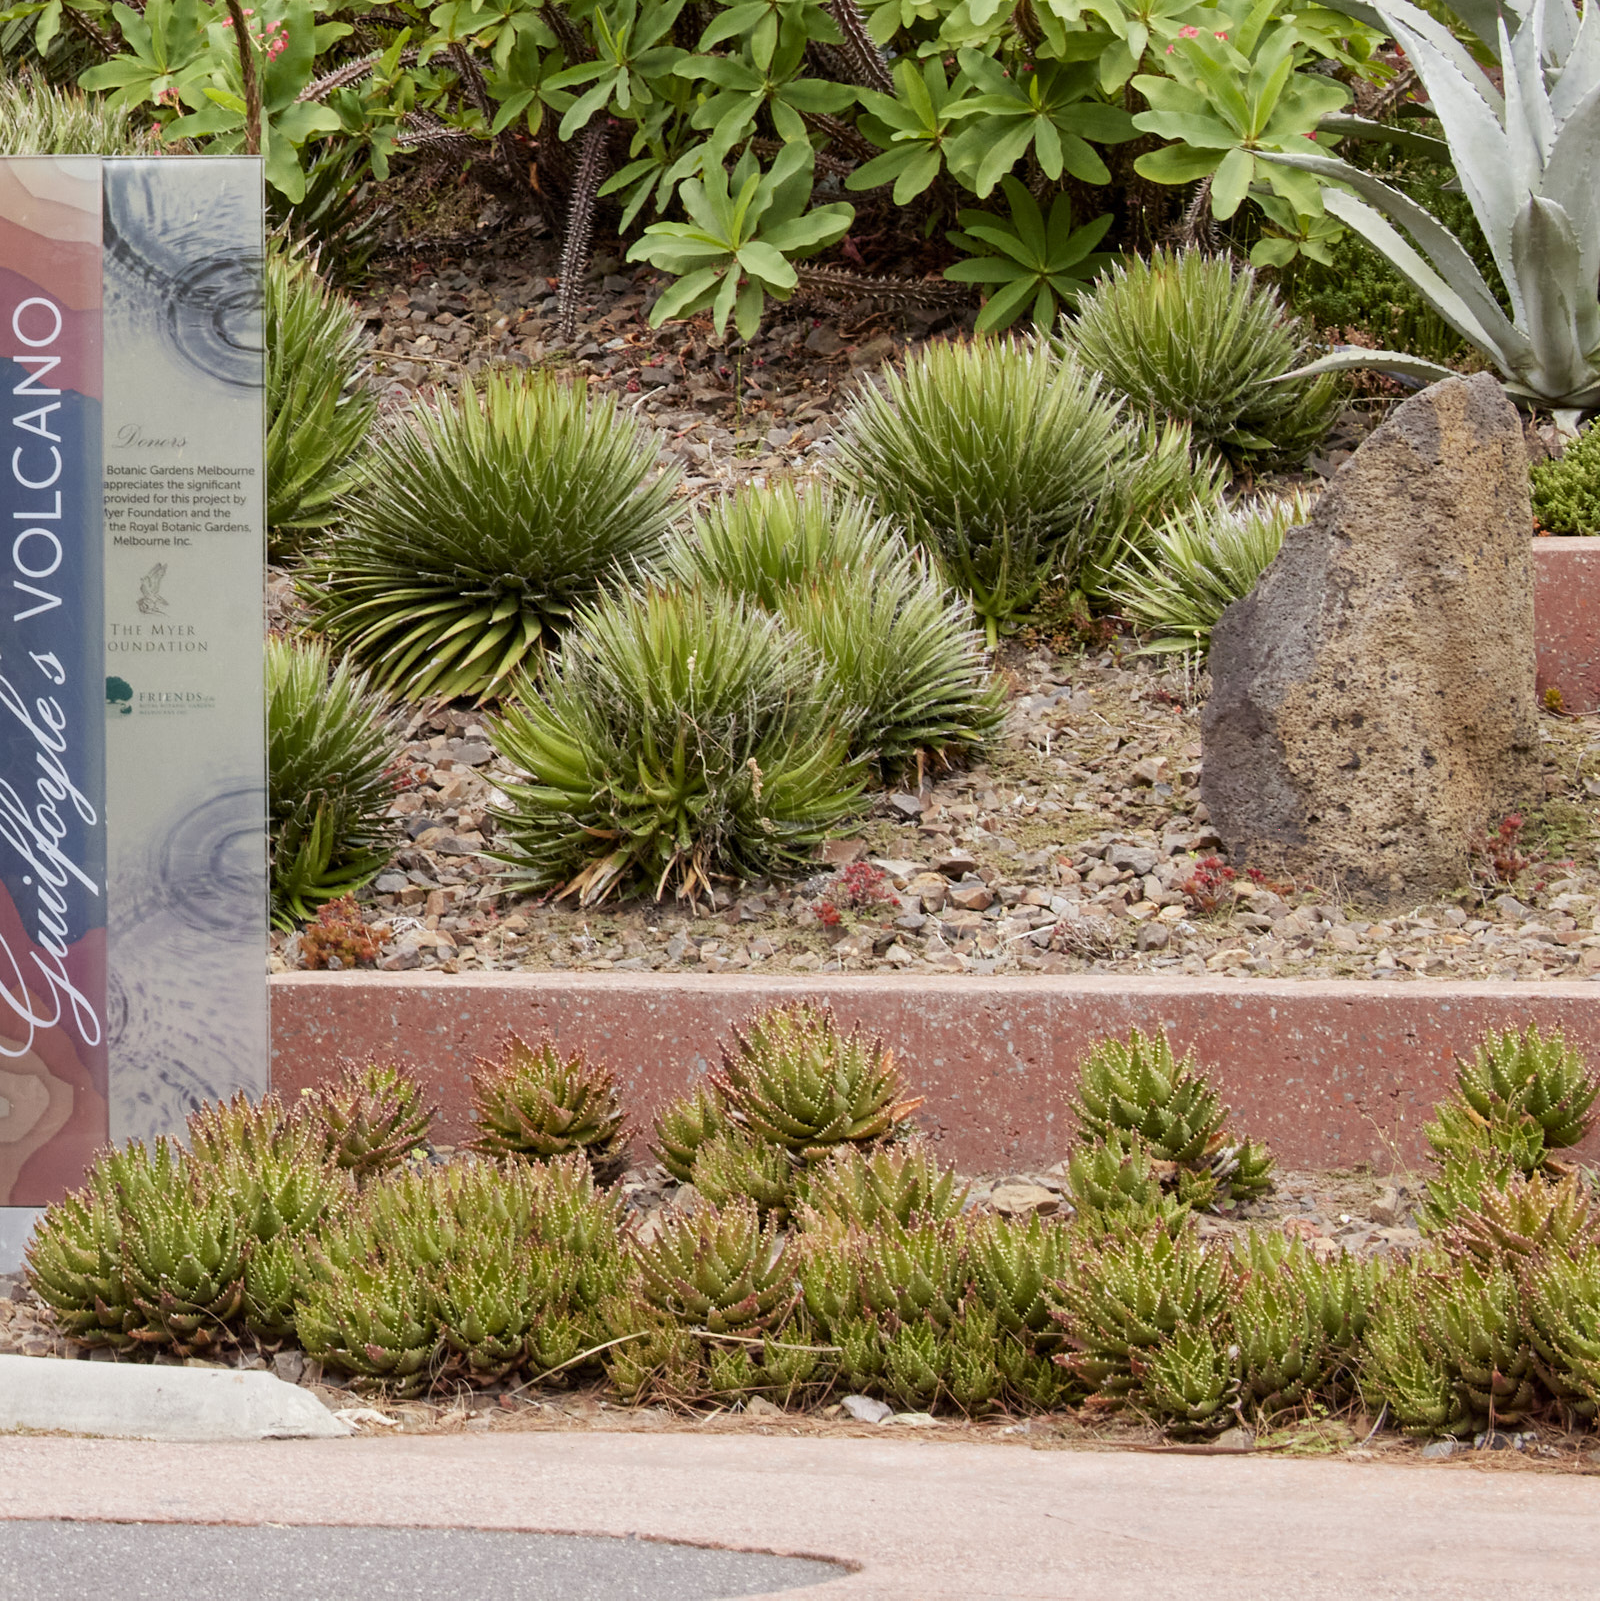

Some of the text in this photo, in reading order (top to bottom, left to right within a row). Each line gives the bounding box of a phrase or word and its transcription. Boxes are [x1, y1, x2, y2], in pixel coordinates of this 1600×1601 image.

[112, 424, 187, 449] Donors
[11, 296, 63, 622] VOLCANO
[107, 466, 255, 475] Botanic Gardens Melbourne
[104, 481, 241, 492] appreciates the significant
[104, 494, 247, 507] provided for this project by
[128, 509, 188, 518] Foundation
[191, 509, 210, 518] and
[213, 509, 231, 518] the
[109, 523, 126, 532] the
[130, 523, 159, 534] Royal
[162, 523, 201, 532] Botanic
[205, 523, 251, 533] Gardens,
[114, 537, 192, 546] Melbourne Inc.
[111, 624, 195, 635] THE MYER
[139, 692, 202, 702] FRIENDS
